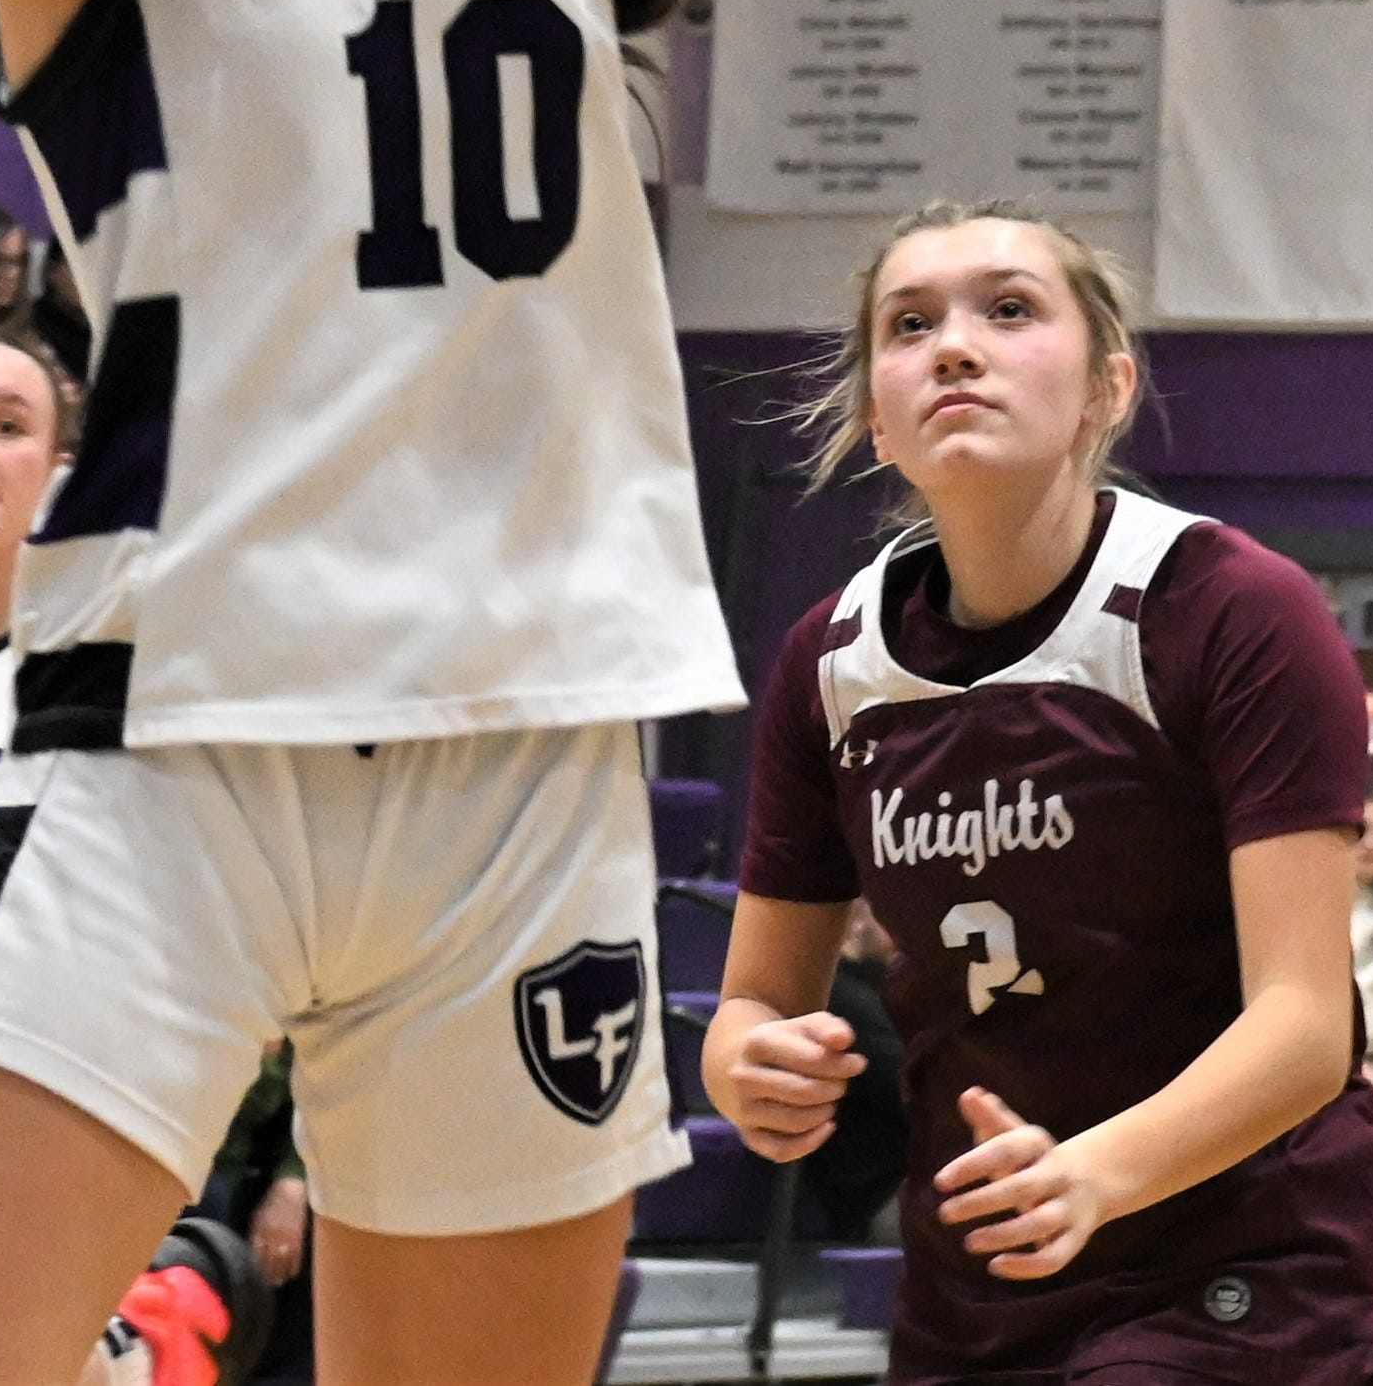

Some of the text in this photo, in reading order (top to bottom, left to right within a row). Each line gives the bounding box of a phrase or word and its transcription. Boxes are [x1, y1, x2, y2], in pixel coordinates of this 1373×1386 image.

[870, 778, 1074, 877] Knights
[939, 899, 1045, 1015] 2
[533, 987, 637, 1093] LF
